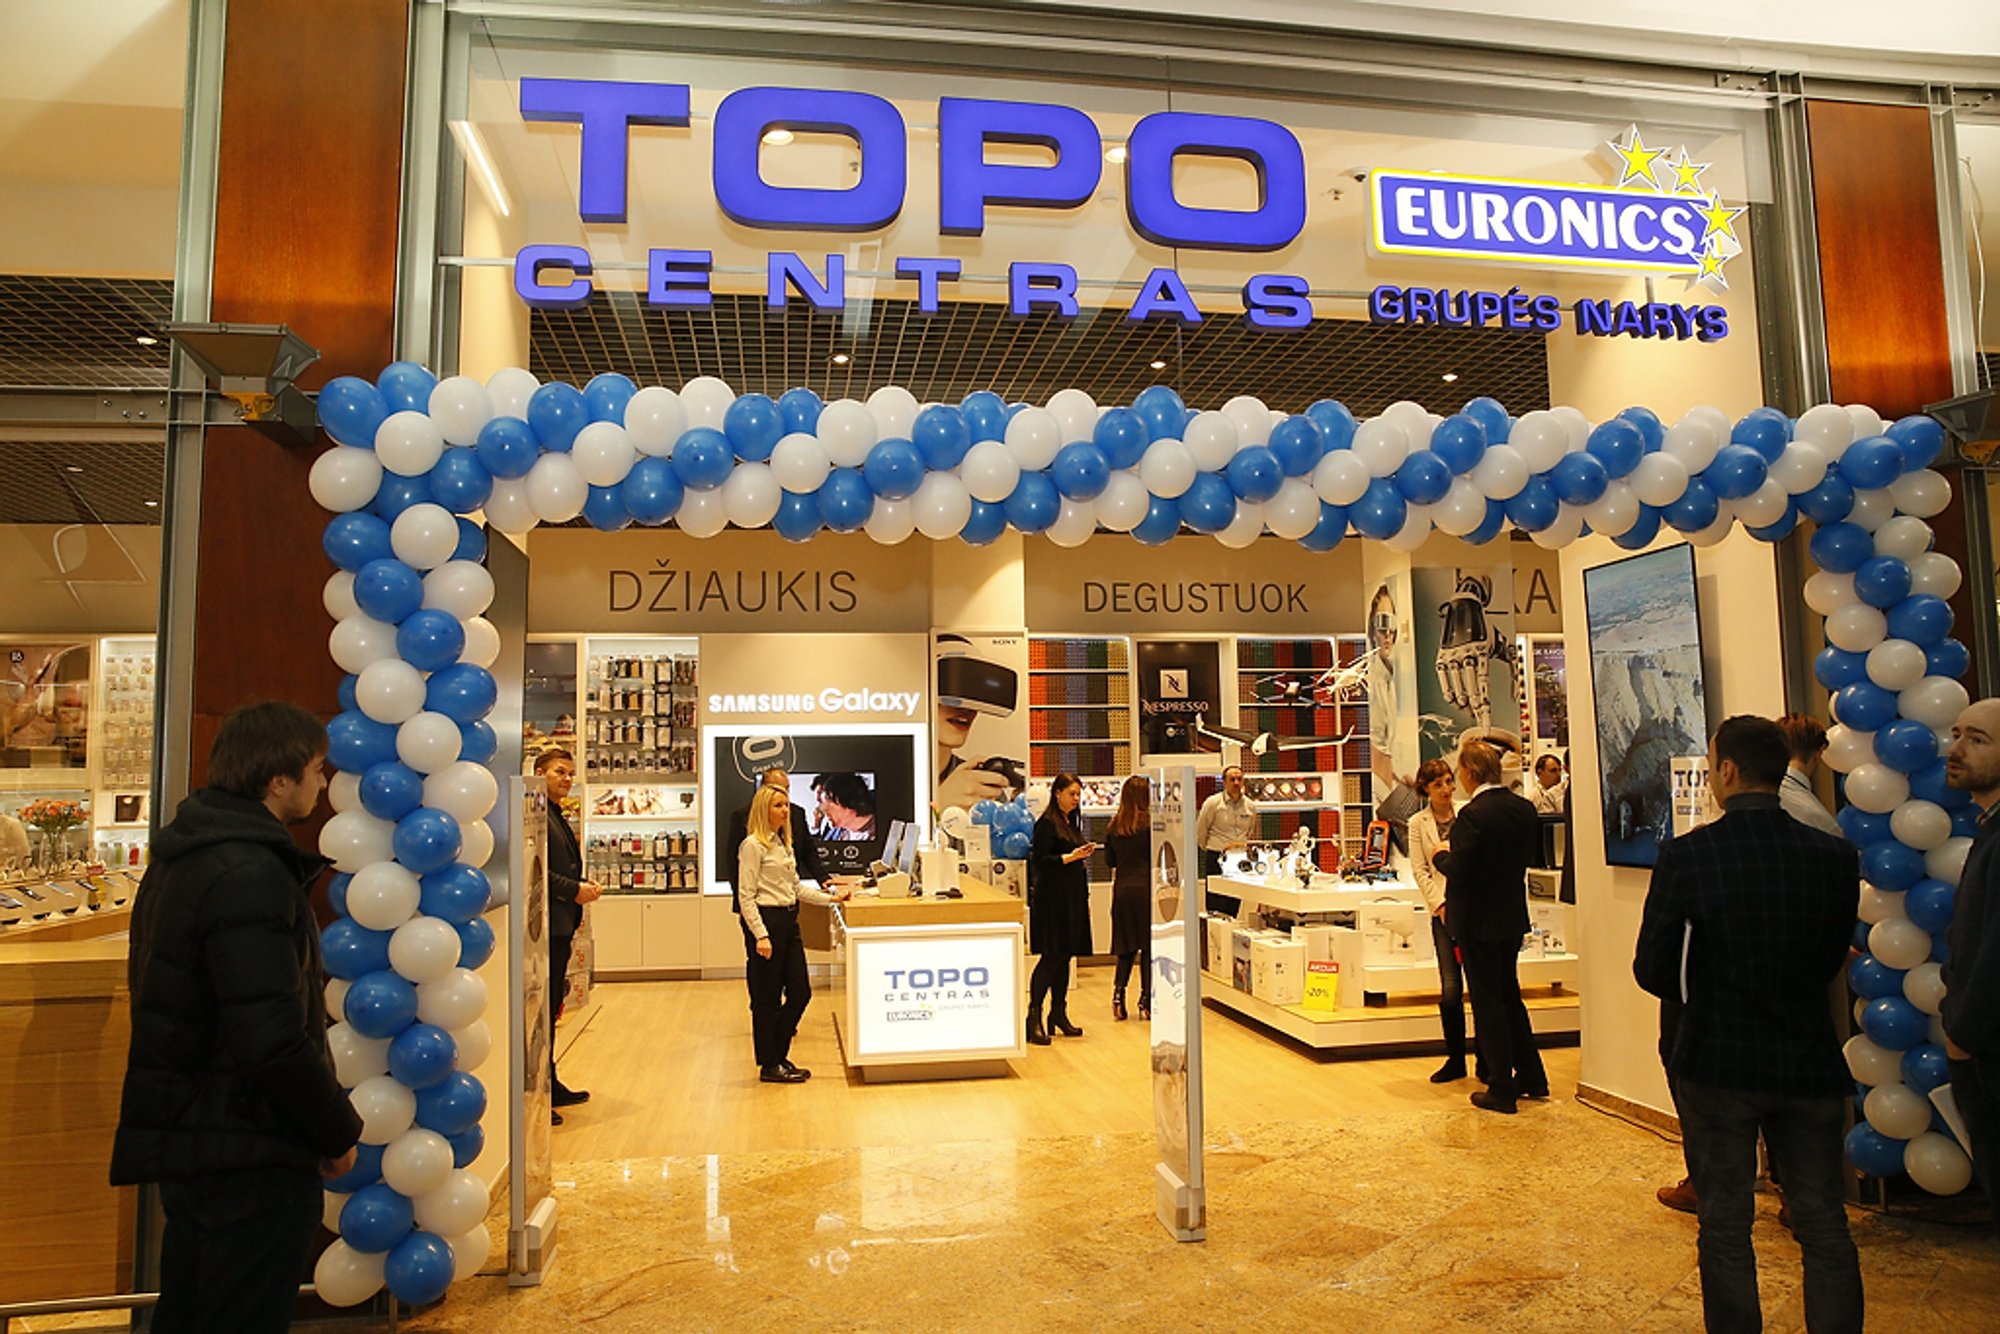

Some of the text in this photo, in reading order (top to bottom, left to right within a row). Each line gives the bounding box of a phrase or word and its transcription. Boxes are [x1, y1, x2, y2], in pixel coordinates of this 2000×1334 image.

[520, 77, 1306, 253] TOPO
[1396, 186, 1696, 256] EURONICS
[514, 245, 1313, 330] CENTRAS
[1576, 299, 1729, 341] NARYS
[609, 558, 858, 613] DŽIAUKIS
[1084, 582, 1309, 613] DEGUSTUOK
[709, 687, 921, 717] SAMSUNG Galaxy
[1141, 699, 1209, 716] NESPRESSO
[1674, 769, 1708, 787] TO
[884, 967, 990, 989] TOPO
[884, 989, 990, 1002] CENTRAS
